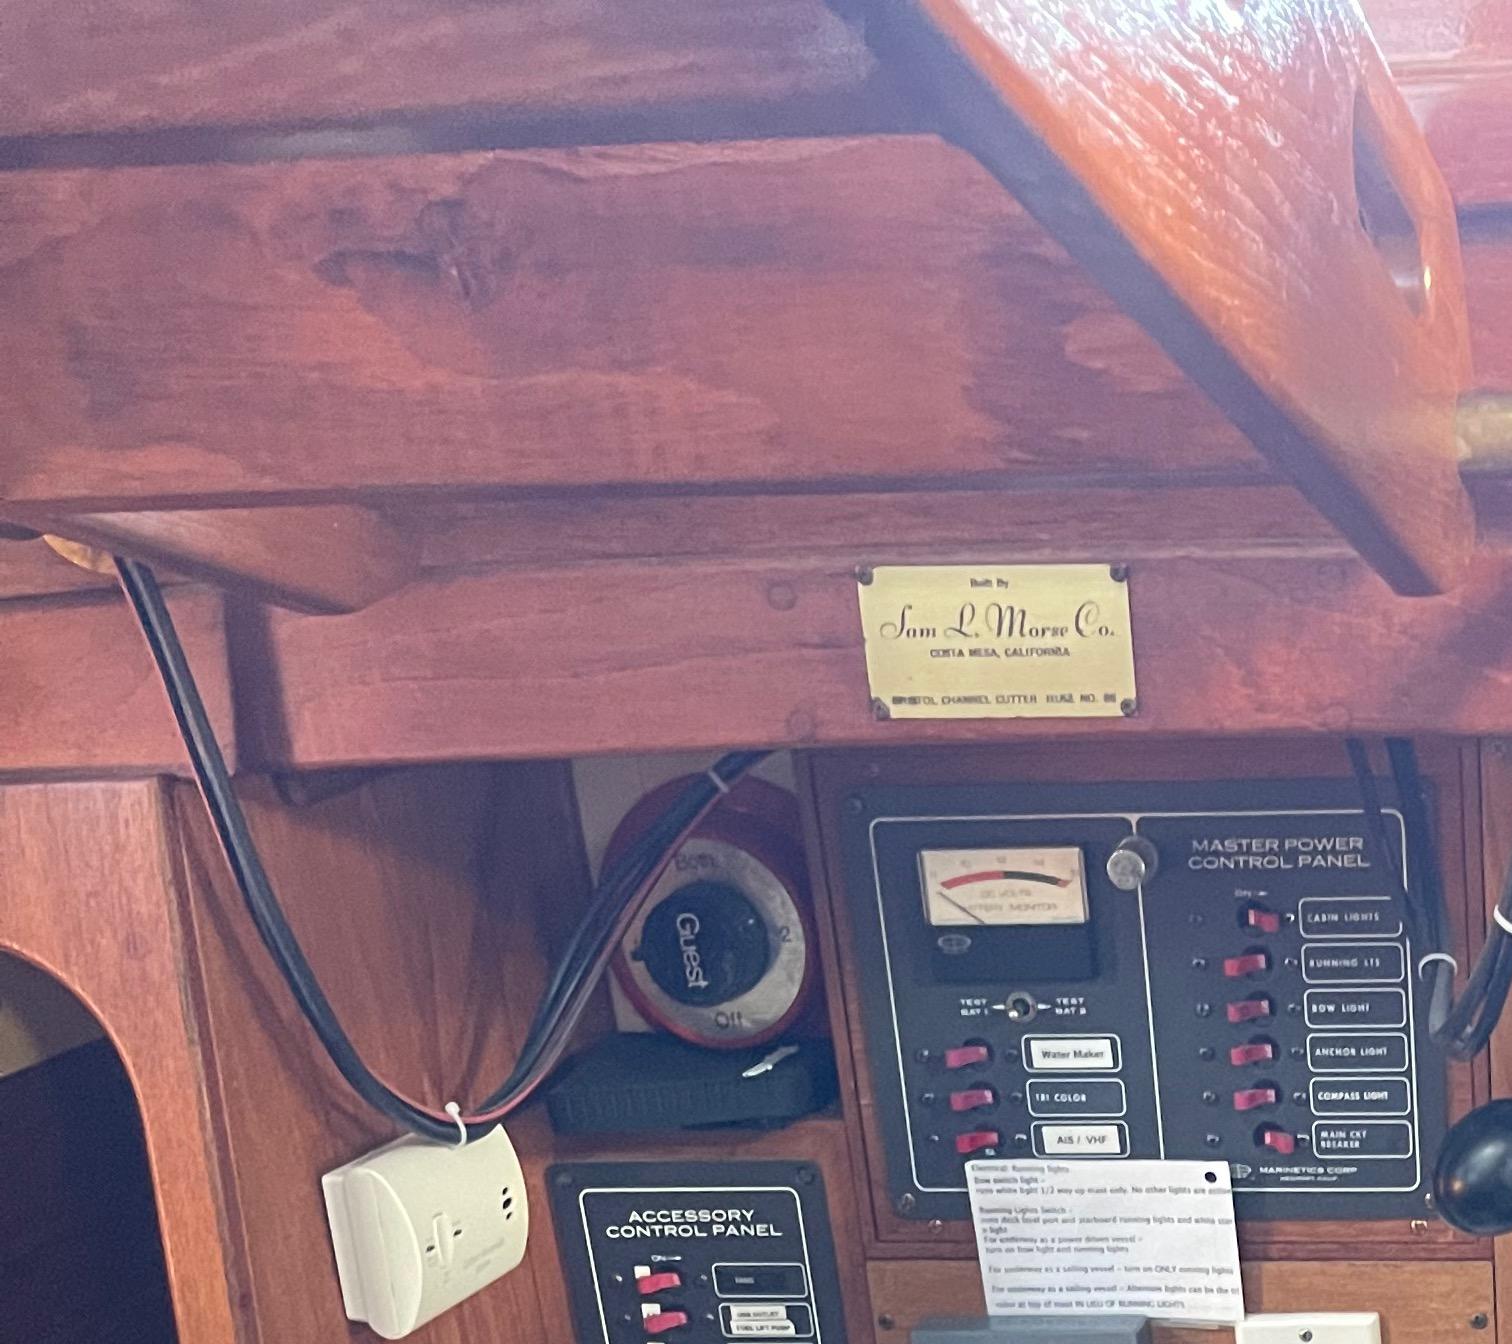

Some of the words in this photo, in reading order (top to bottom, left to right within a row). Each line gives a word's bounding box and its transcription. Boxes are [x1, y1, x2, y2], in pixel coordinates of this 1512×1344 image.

[996, 578, 1008, 590] By
[880, 604, 937, 640] Sam
[985, 602, 1068, 638] Morse
[1074, 600, 1115, 638] Co.
[930, 648, 965, 658] COSTA
[1005, 647, 1070, 658] CALIFORNIA
[892, 696, 937, 705] BRISTOL
[941, 695, 991, 705] CHANNEL
[996, 694, 1037, 704] CUTTER
[1192, 839, 1279, 853] MASTER
[1285, 837, 1364, 851] POWER
[1188, 856, 1293, 869] CONTROL
[1298, 854, 1371, 868] PANEL
[1235, 889, 1251, 897] ON
[1308, 913, 1339, 922] CABIN
[1344, 912, 1380, 922] LIGHTS
[779, 926, 791, 943] 2
[676, 912, 709, 988] Guest
[1309, 958, 1358, 968] RUNNING
[1055, 997, 1084, 1005] TEST
[1311, 1004, 1335, 1012] BOW
[1341, 1003, 1370, 1012] LIGHT
[714, 1011, 743, 1029] Off
[1042, 1050, 1070, 1059] Water
[1074, 1049, 1104, 1059] Maker
[1315, 1047, 1356, 1056] ANCHOR
[1360, 1047, 1388, 1056] LIGHT
[1035, 1093, 1050, 1102] TRI
[1054, 1093, 1087, 1102] COLOR
[1317, 1092, 1360, 1101] COMPASS
[1363, 1091, 1388, 1100] LIGHT
[1057, 1135, 1074, 1144] AIS
[1087, 1135, 1107, 1144] VHF
[1320, 1131, 1346, 1139] MAIN
[1320, 1140, 1360, 1149] BREAKER
[1041, 1186, 1054, 1195] 1/2
[628, 1210, 754, 1223] ACCESSORY
[606, 1224, 707, 1238] CONTROL
[713, 1224, 782, 1237] PANEL
[1155, 1265, 1176, 1273] ONLY
